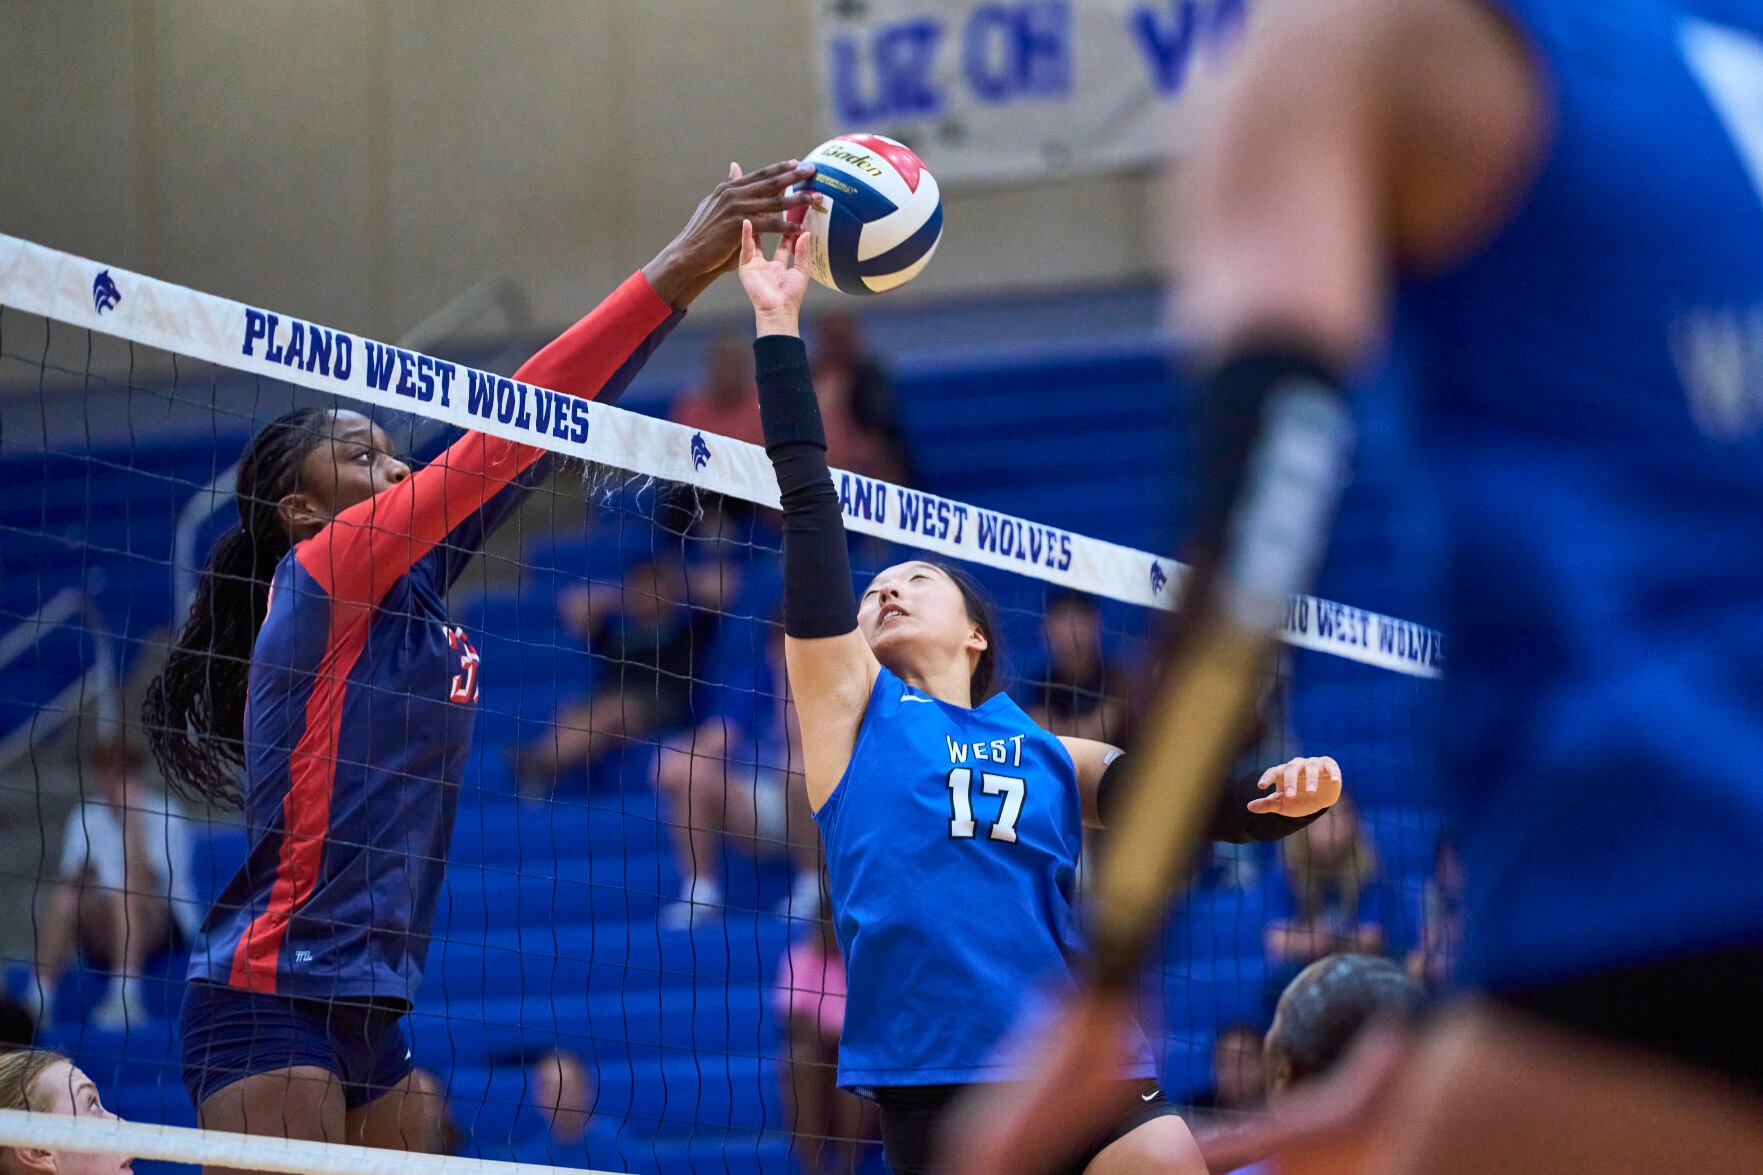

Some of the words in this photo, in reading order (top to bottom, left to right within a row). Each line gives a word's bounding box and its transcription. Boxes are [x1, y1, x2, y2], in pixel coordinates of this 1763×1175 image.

[242, 308, 353, 381] PLANO
[364, 341, 456, 408] WEST
[467, 369, 590, 445] WOLVES
[839, 474, 887, 524] ANO
[897, 489, 968, 545] WEST
[977, 511, 1072, 572] WOLVES
[1316, 600, 1370, 648] WEST
[946, 733, 1026, 768] WEST
[945, 766, 1028, 846] 17
